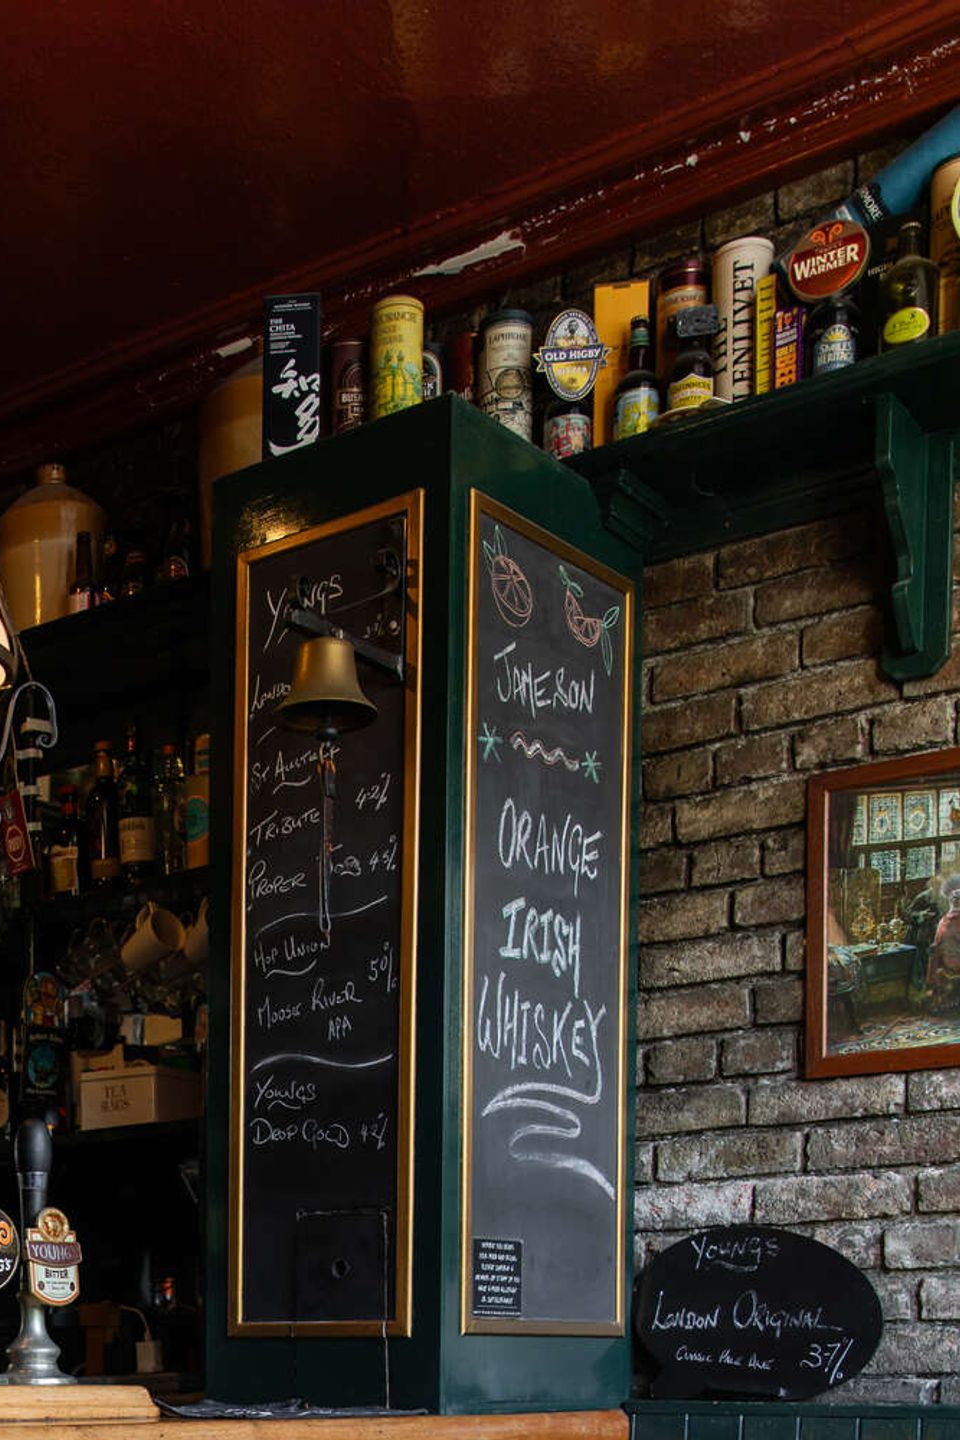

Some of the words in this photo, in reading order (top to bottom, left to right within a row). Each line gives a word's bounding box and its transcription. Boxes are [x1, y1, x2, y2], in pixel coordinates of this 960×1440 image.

[793, 243, 859, 281] WINTER
[269, 324, 296, 332] CHITA
[732, 260, 754, 403] LENLIVET
[544, 353, 568, 362] OLD
[569, 348, 602, 360] HIGBY
[494, 641, 596, 719] JAMESON
[250, 808, 321, 848] TRIBUTE
[499, 798, 602, 894] ORANGE
[249, 860, 307, 903] PROPER
[254, 940, 279, 973] HOP
[498, 896, 583, 998] IRISH
[311, 978, 364, 1012] RIVER
[328, 1015, 353, 1042] APA
[478, 972, 607, 1080] WHISKEY
[104, 1084, 127, 1098] TEA
[250, 1117, 299, 1146] DROP
[691, 1236, 781, 1270] YOUNGS
[44, 1268, 69, 1279] BITTER
[651, 1290, 722, 1332] LONDON
[732, 1289, 844, 1338] ORIGINAL
